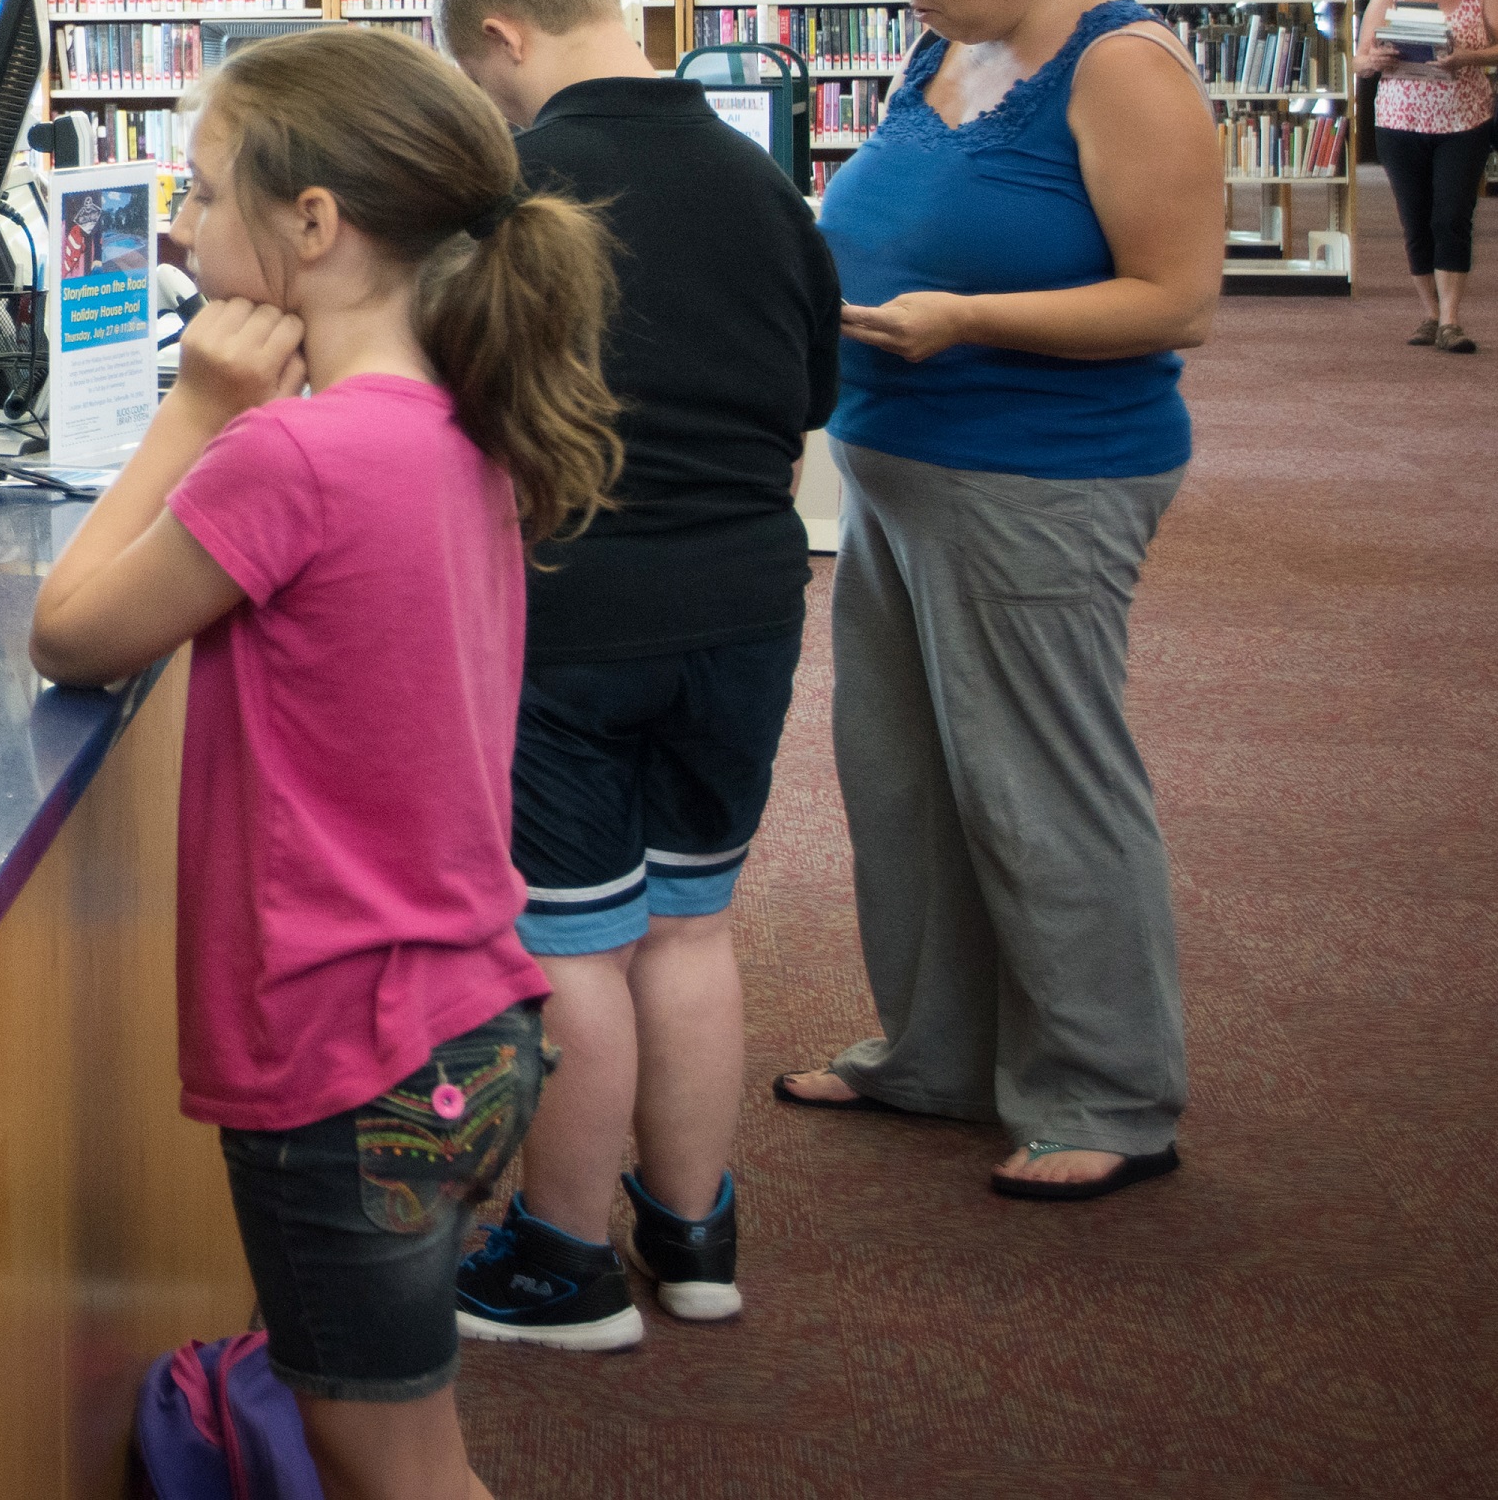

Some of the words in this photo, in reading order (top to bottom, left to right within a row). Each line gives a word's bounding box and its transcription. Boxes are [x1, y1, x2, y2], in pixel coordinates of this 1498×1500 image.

[728, 114, 740, 122] All
[63, 284, 99, 301] Storytime
[101, 284, 111, 294] on
[113, 280, 125, 292] the
[127, 275, 147, 290] Road
[71, 308, 98, 322] Holiday
[100, 305, 123, 317] House
[125, 300, 140, 313] Pool
[94, 327, 104, 338] July
